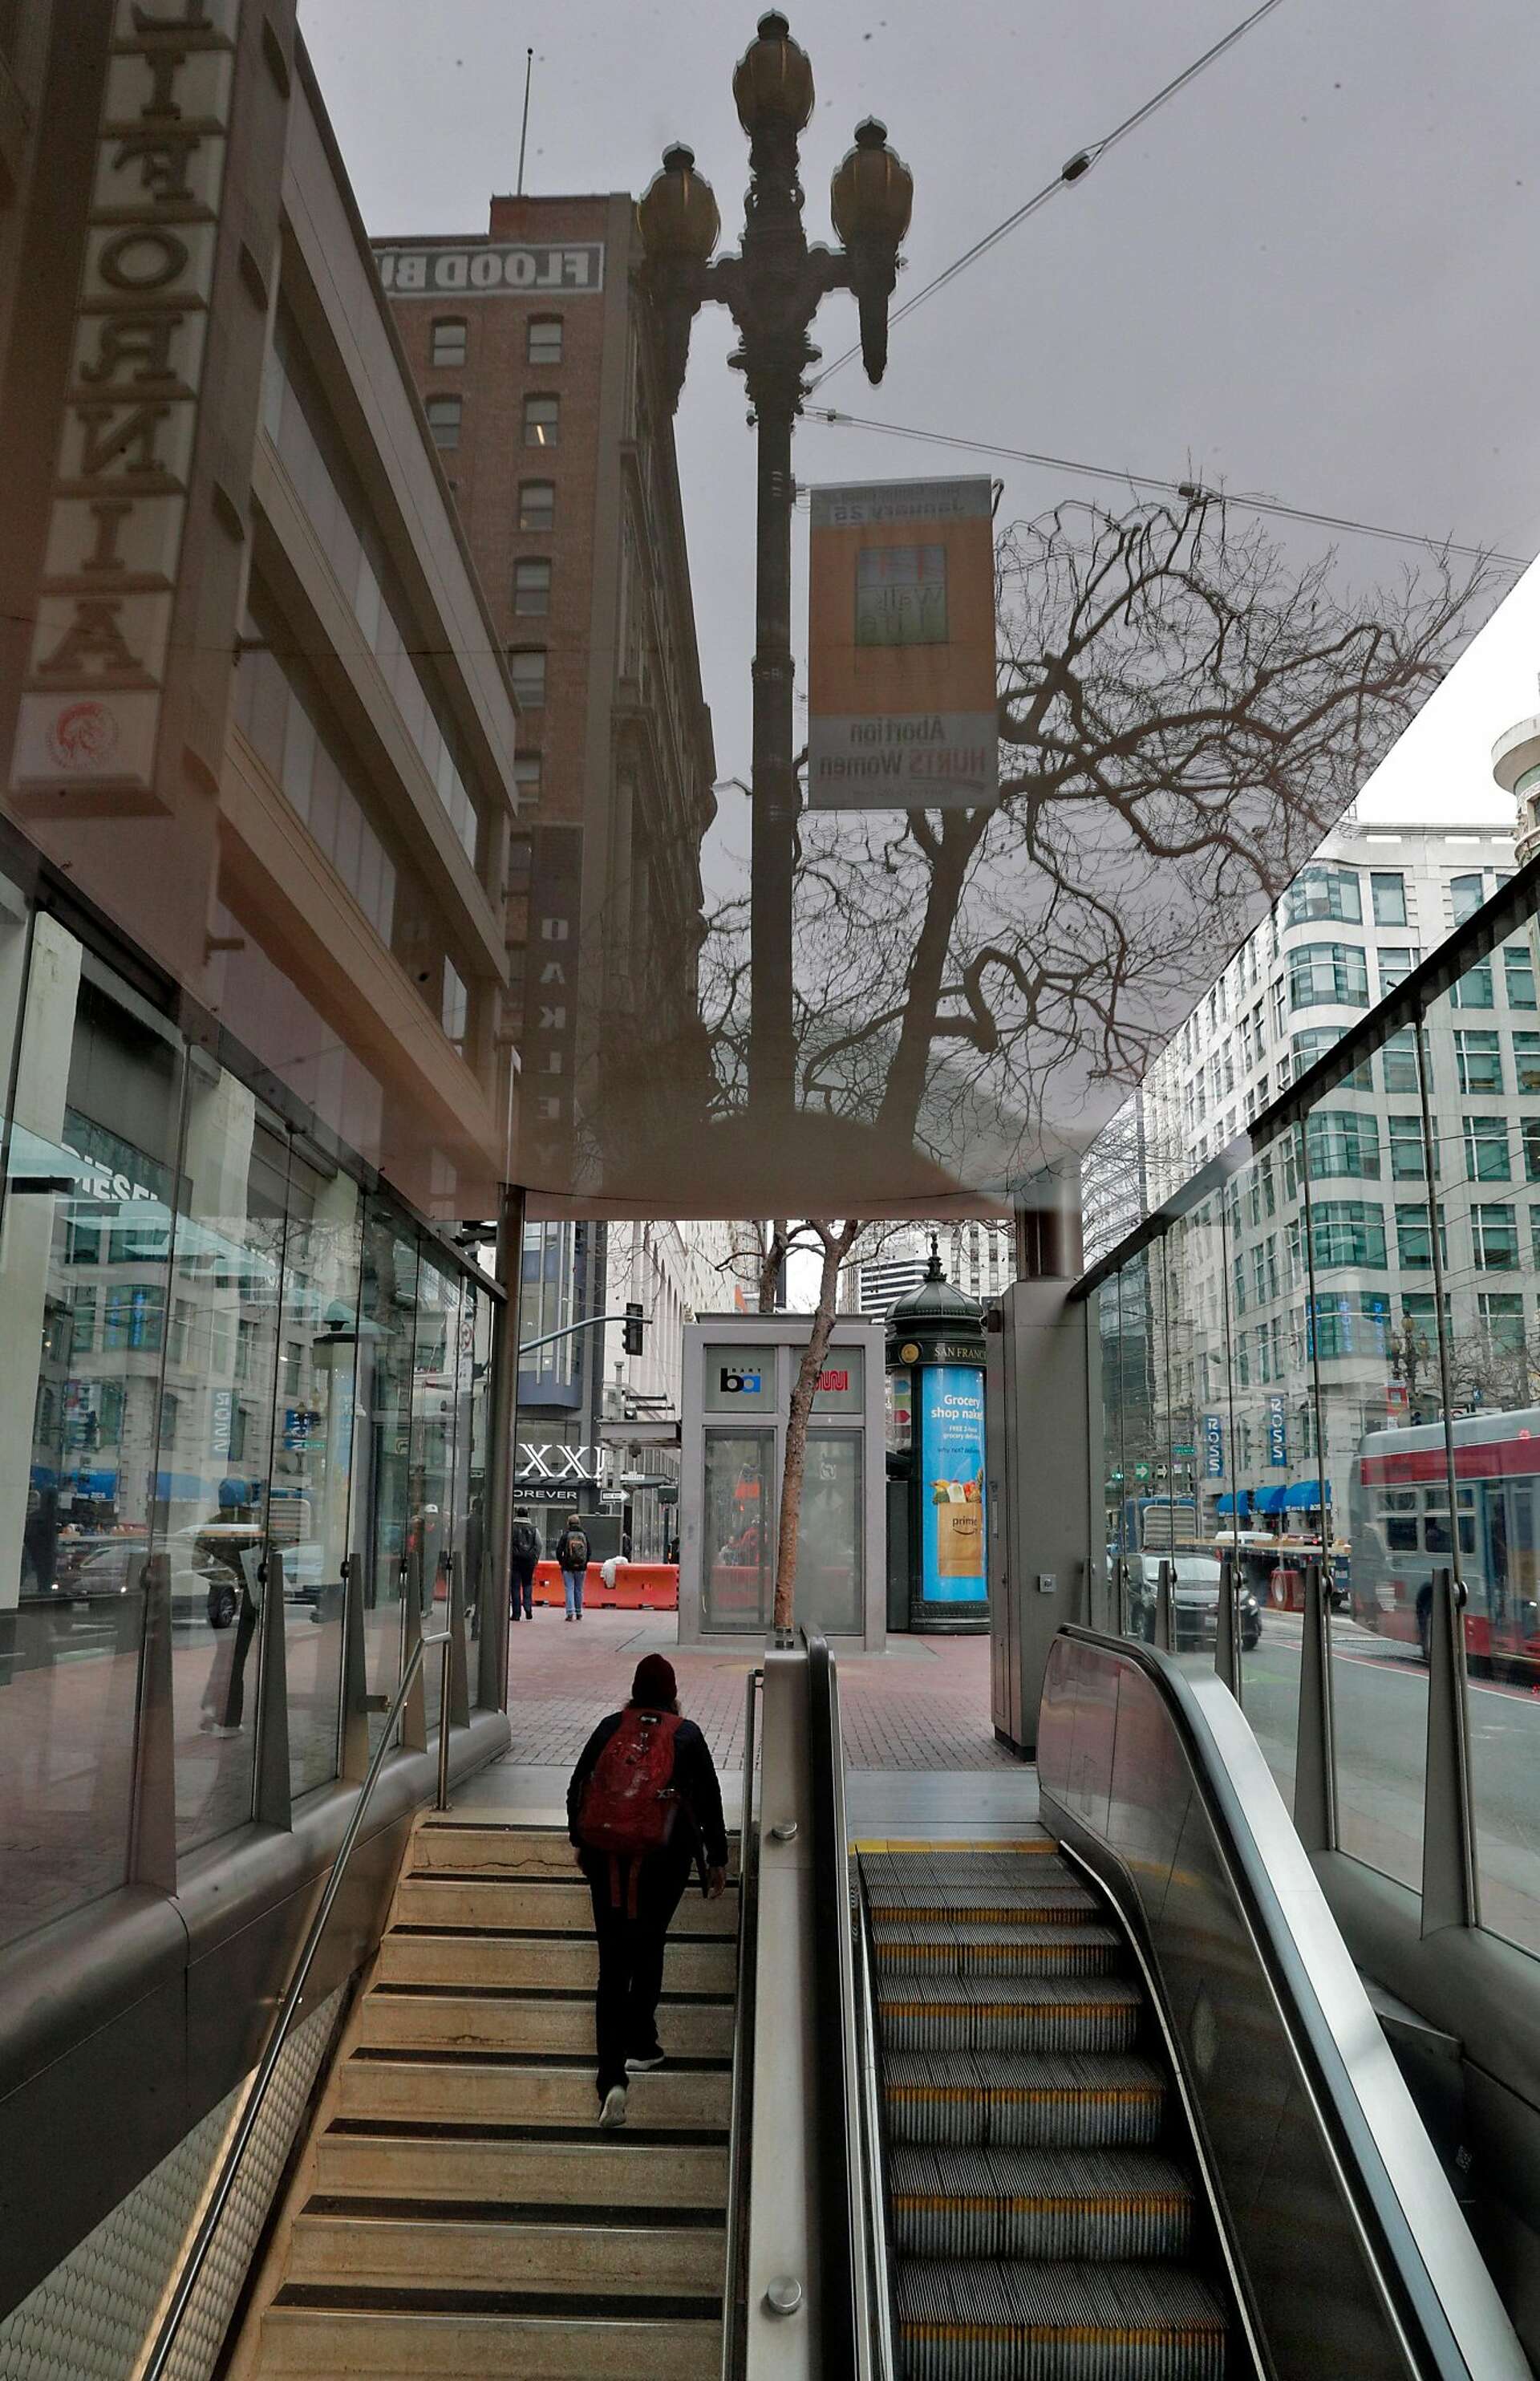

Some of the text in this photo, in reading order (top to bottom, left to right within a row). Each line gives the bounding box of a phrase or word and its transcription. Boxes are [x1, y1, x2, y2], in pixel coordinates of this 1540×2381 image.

[934, 1347, 955, 1357] SAN
[944, 1394, 980, 1410] Grocery
[930, 1407, 959, 1421] shop
[1270, 1398, 1284, 1458] ROSS
[1207, 1418, 1220, 1471] ROSS
[952, 1515, 978, 1527] prime
